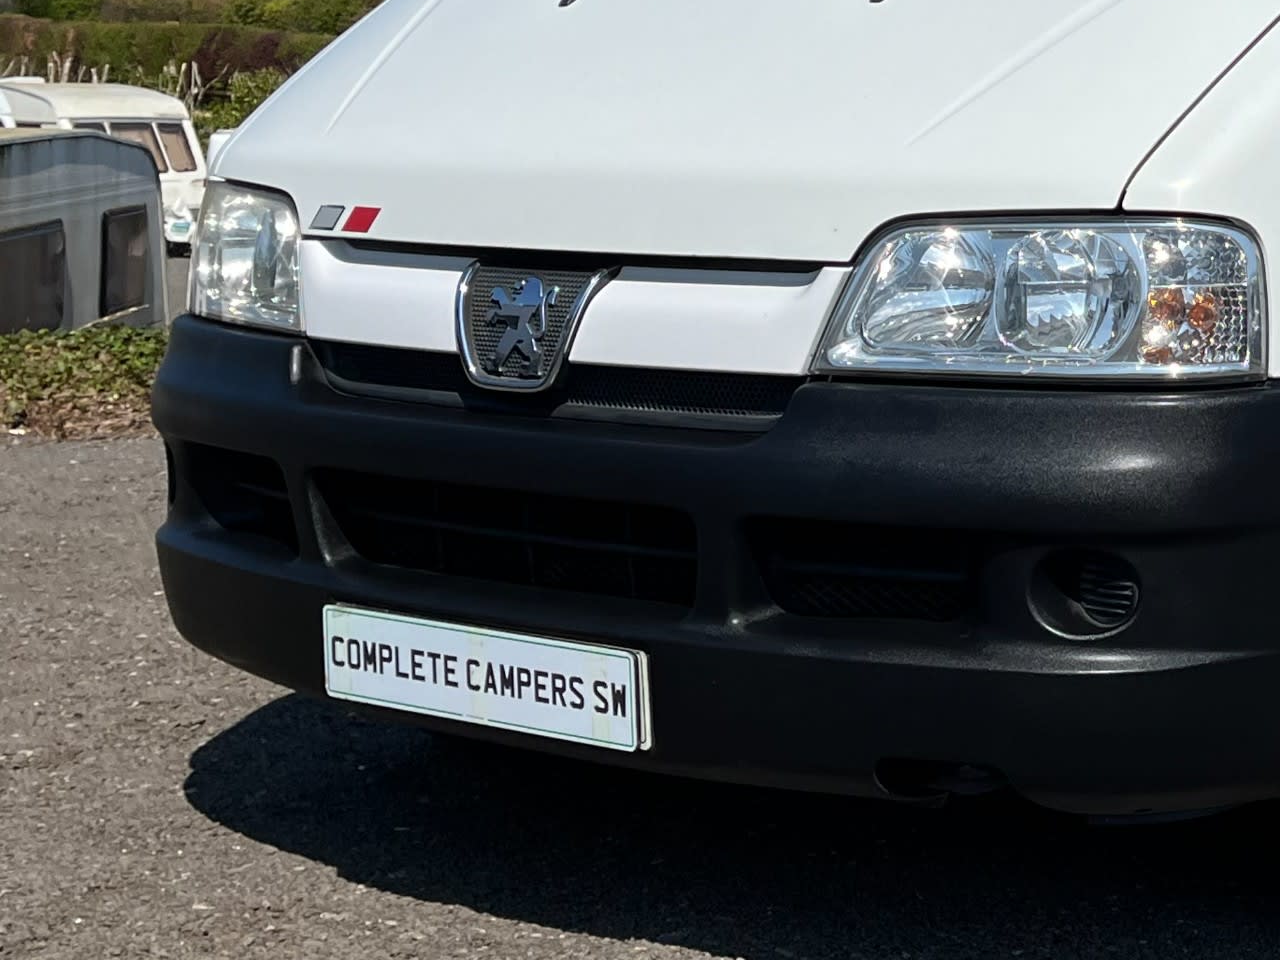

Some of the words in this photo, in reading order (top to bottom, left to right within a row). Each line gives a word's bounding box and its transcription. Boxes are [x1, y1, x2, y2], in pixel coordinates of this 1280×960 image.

[331, 636, 459, 688] COMPLETE
[466, 659, 586, 710] CAMPERS
[592, 680, 628, 718] SW
